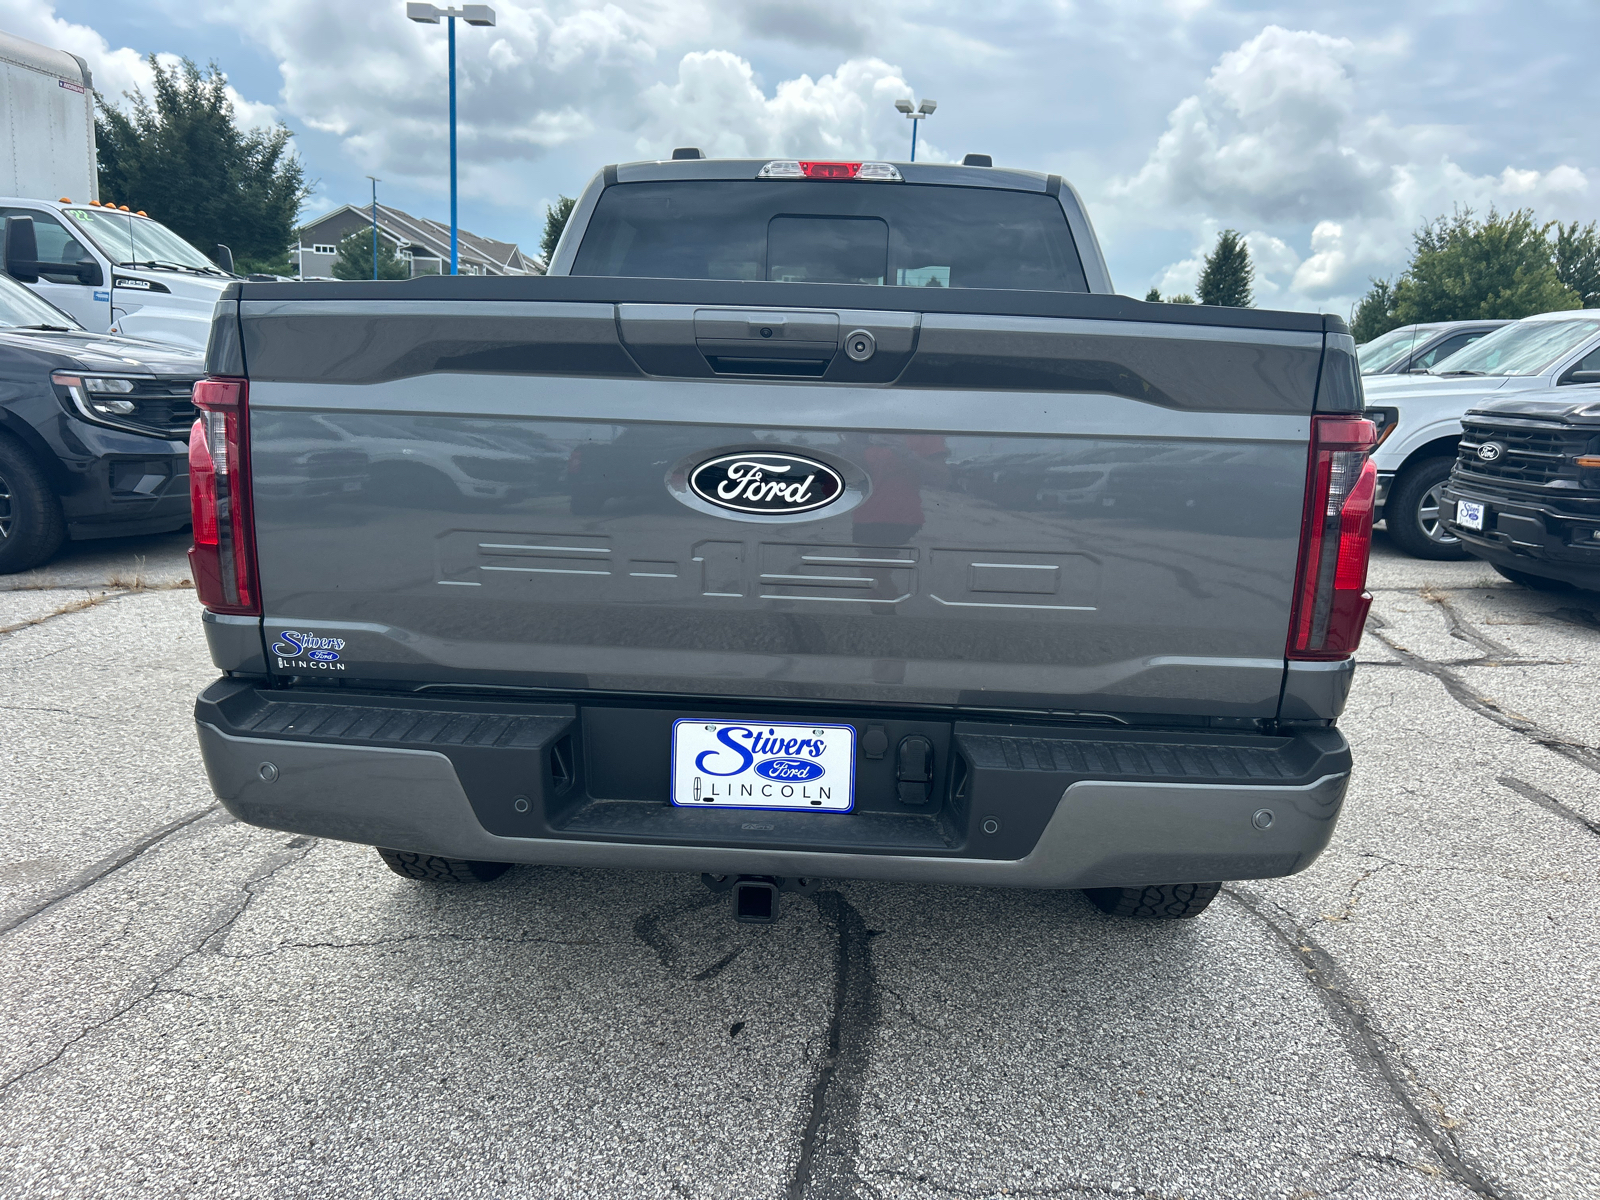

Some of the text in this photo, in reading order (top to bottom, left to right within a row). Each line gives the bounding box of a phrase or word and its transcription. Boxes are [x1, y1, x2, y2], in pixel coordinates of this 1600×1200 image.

[70, 210, 94, 221] 22
[717, 462, 815, 503] Ford
[435, 528, 1101, 611] F-150
[272, 630, 345, 658] Stivers
[314, 651, 333, 660] Ford
[283, 660, 345, 670] LINCOLN
[695, 726, 827, 777] Stivers
[768, 760, 810, 778] Ford
[711, 783, 831, 800] LINCOLN
